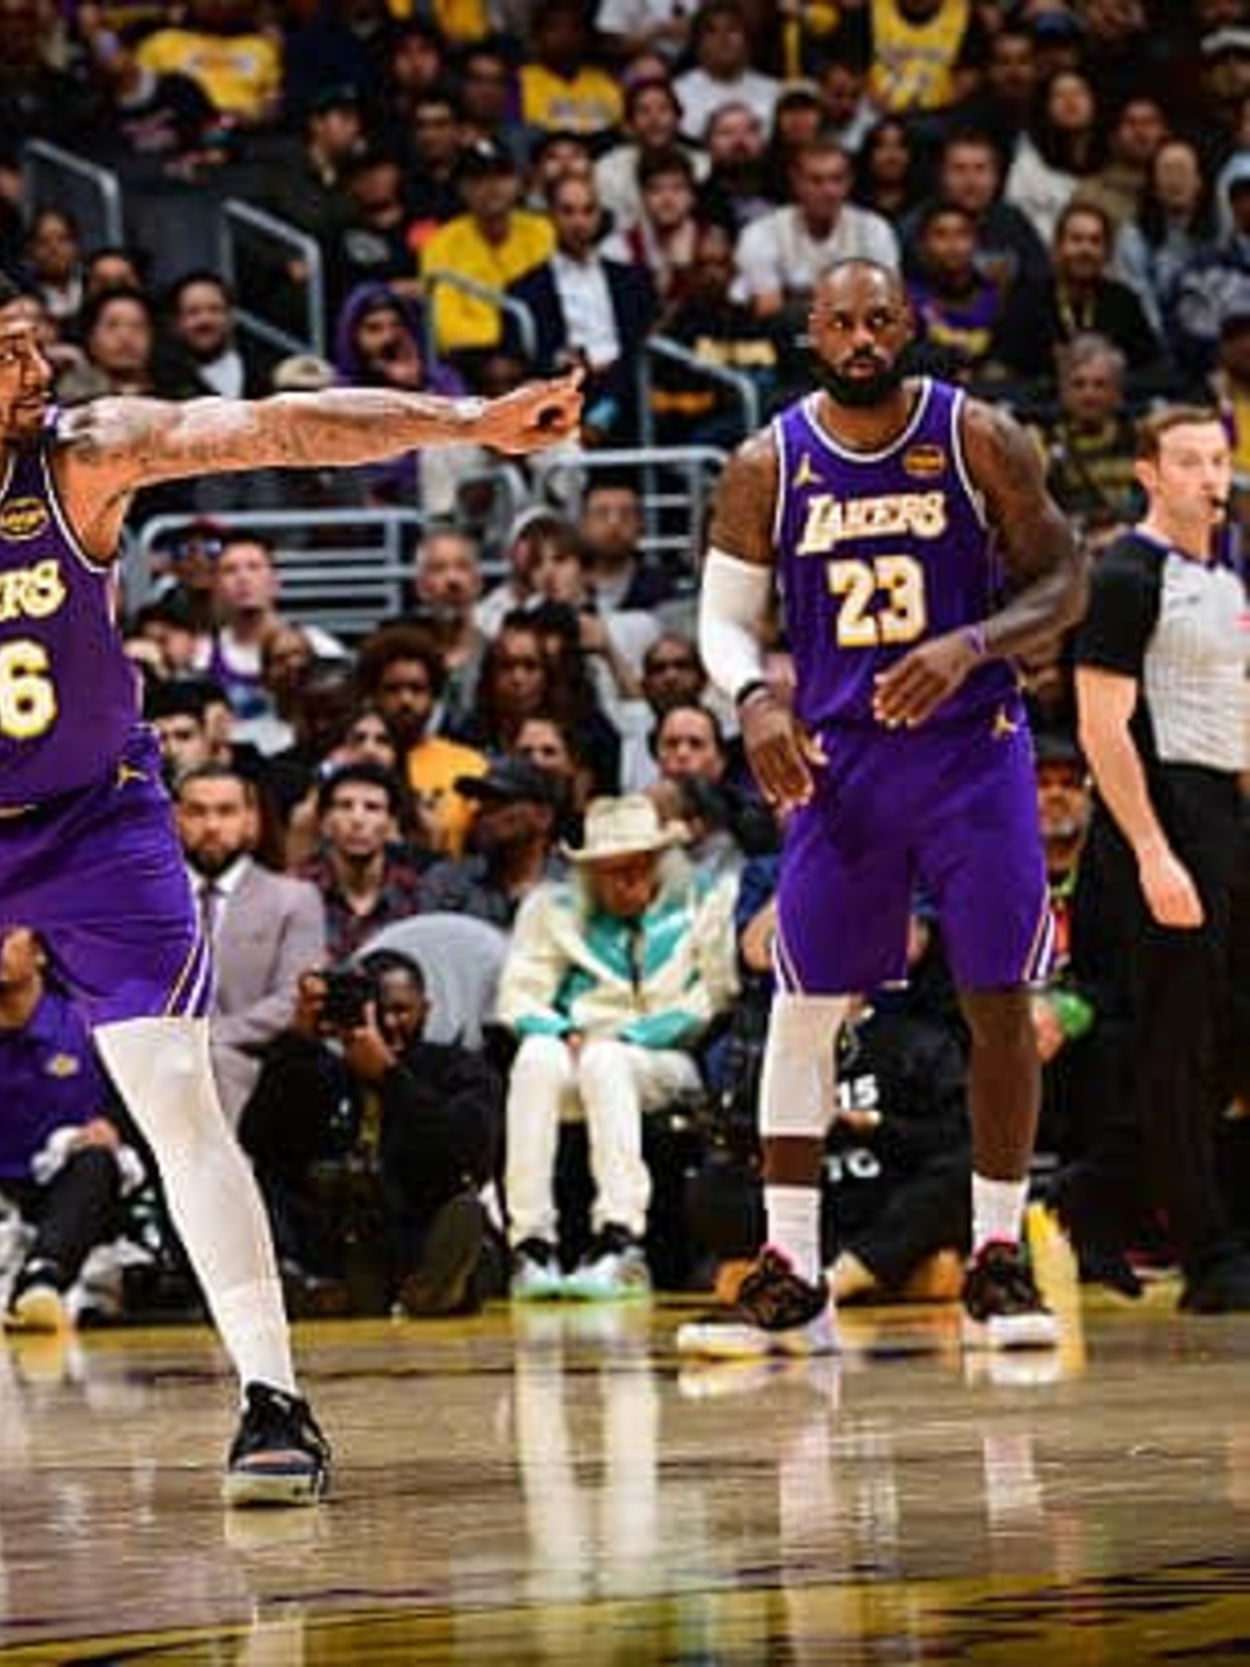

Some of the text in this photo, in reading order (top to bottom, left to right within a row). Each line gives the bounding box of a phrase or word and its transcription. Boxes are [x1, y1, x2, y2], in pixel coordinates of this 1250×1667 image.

[796, 492, 946, 556] LAKERS
[826, 554, 927, 648] 23
[839, 1073, 880, 1111] 15
